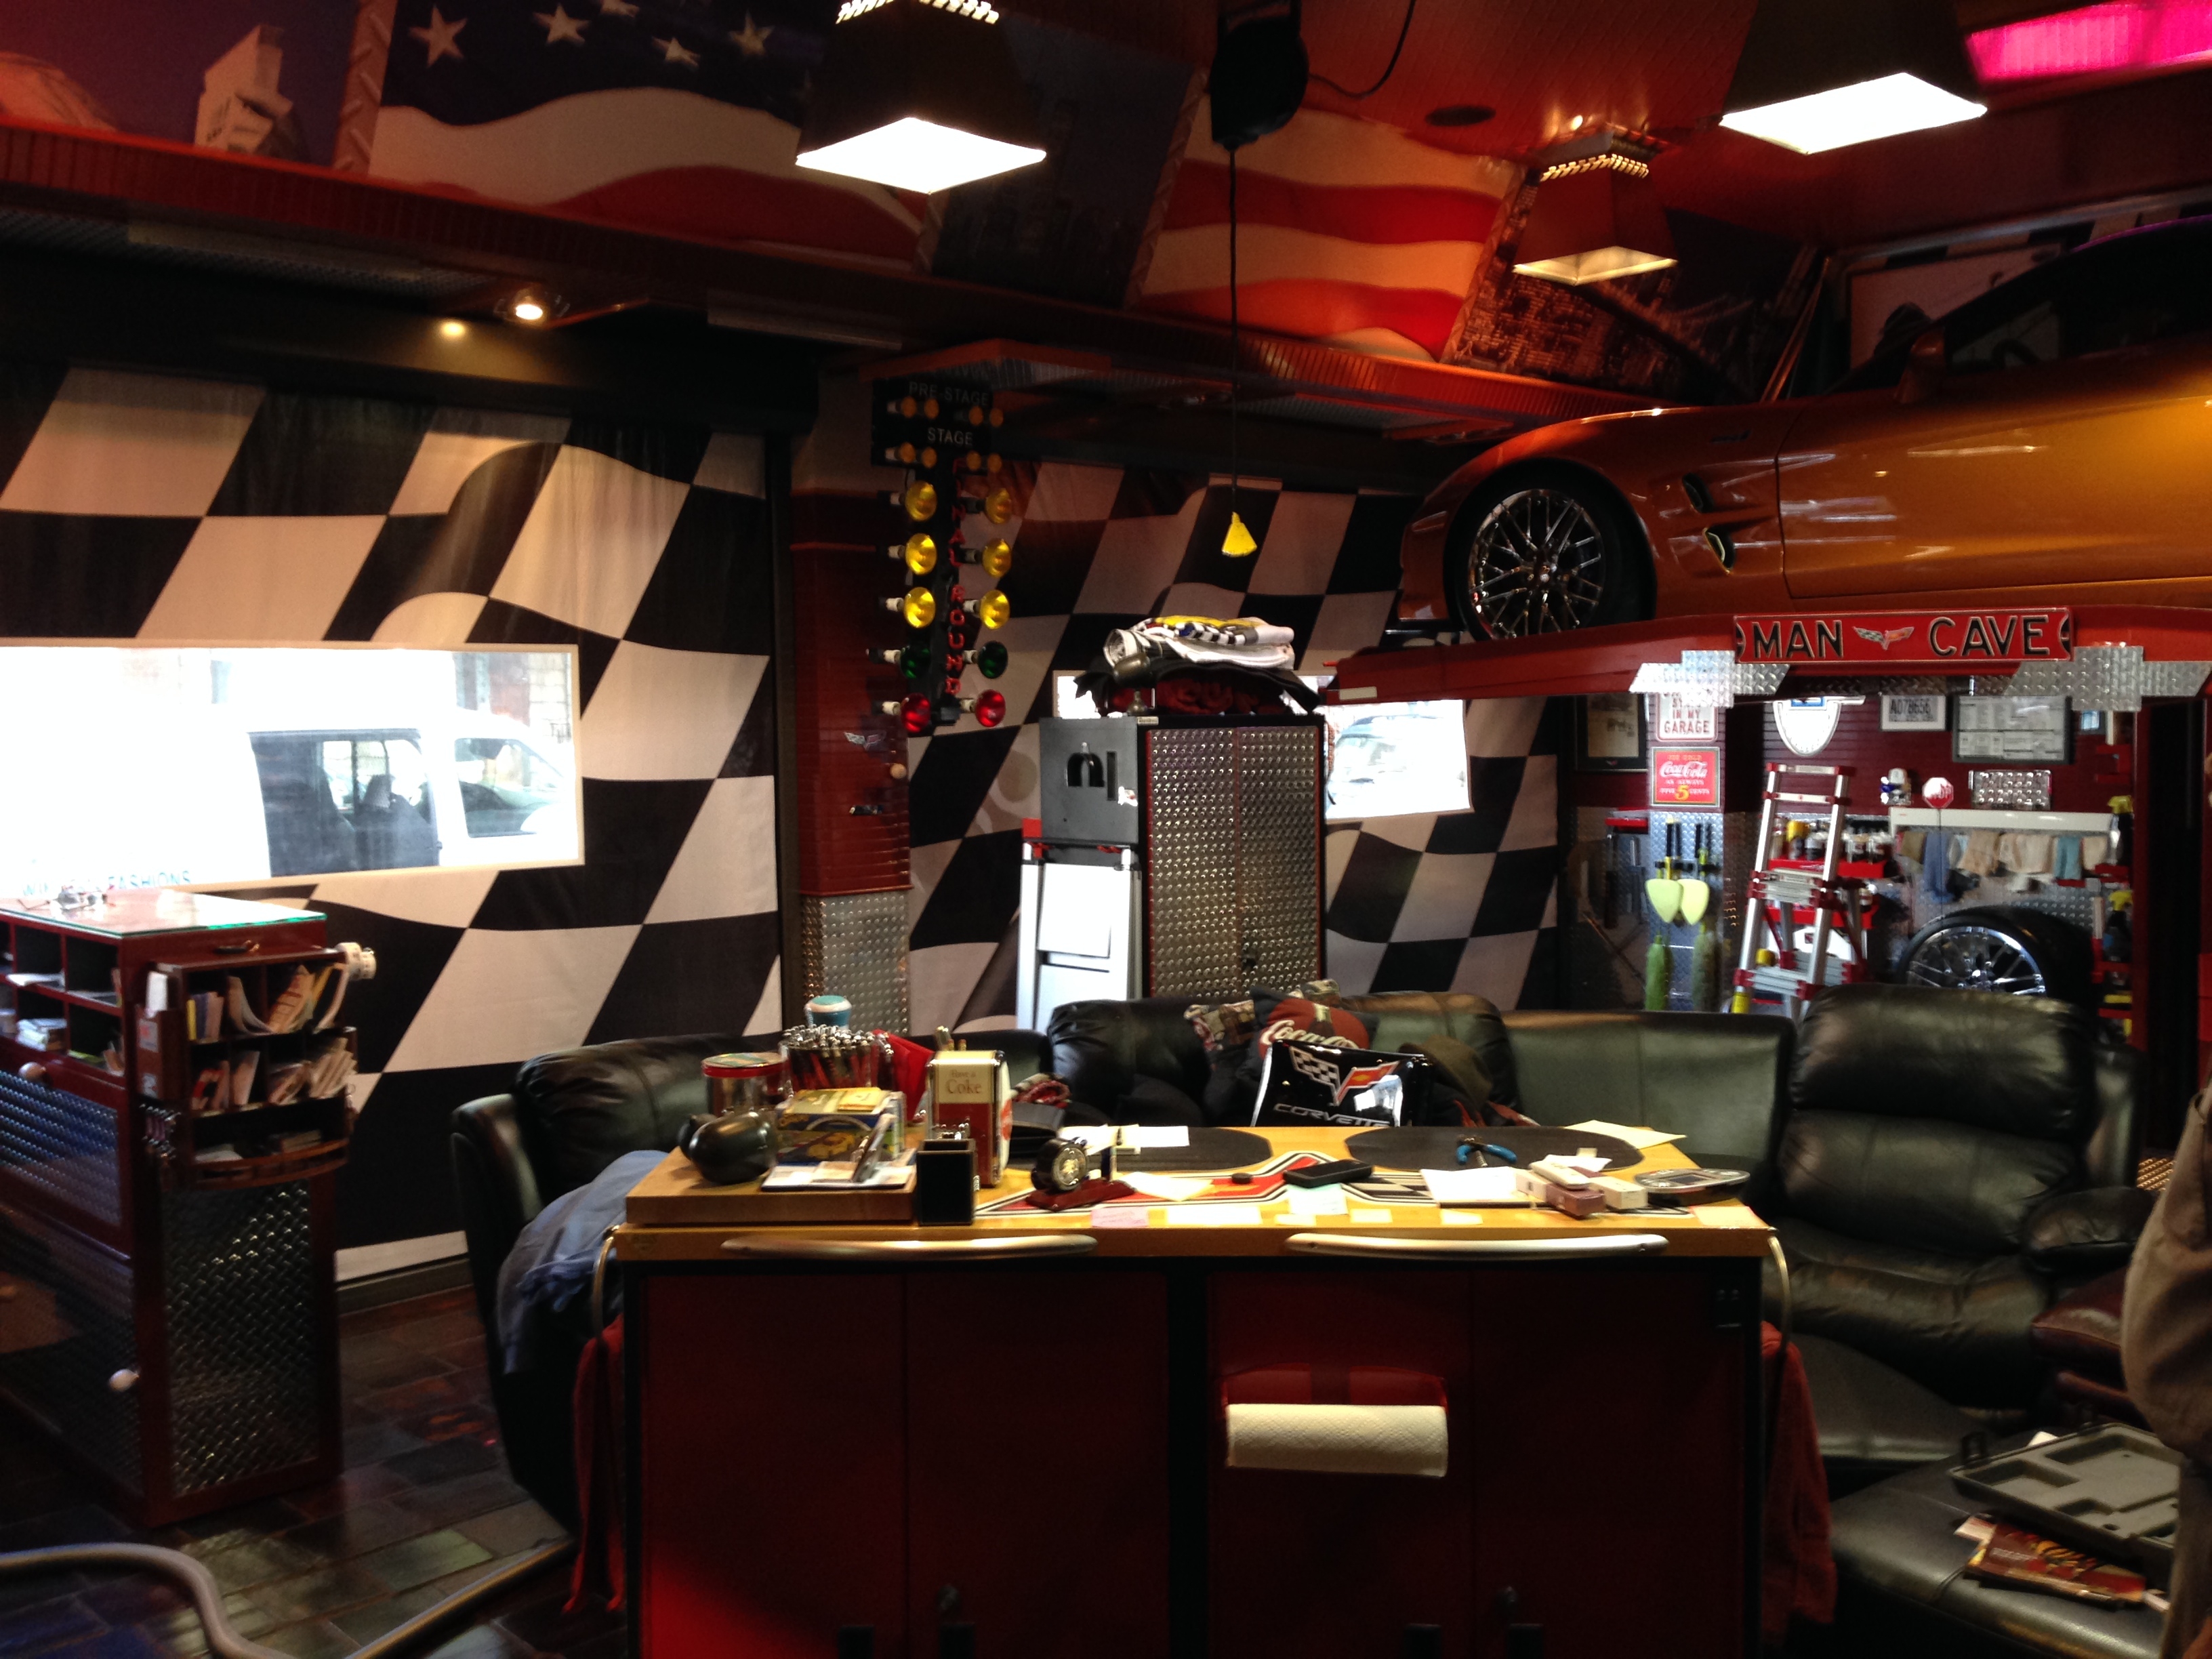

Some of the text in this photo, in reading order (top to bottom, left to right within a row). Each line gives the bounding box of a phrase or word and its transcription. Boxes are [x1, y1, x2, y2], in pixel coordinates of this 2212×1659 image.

[927, 427, 974, 446] STAGE
[1751, 615, 2050, 659] MAN CAVE
[1672, 710, 1700, 719] IN MY
[1664, 720, 1710, 733] GARAGE
[1675, 784, 1690, 801] 5
[945, 1078, 982, 1094] Coke
[1274, 1103, 1390, 1126] CORVETTE
